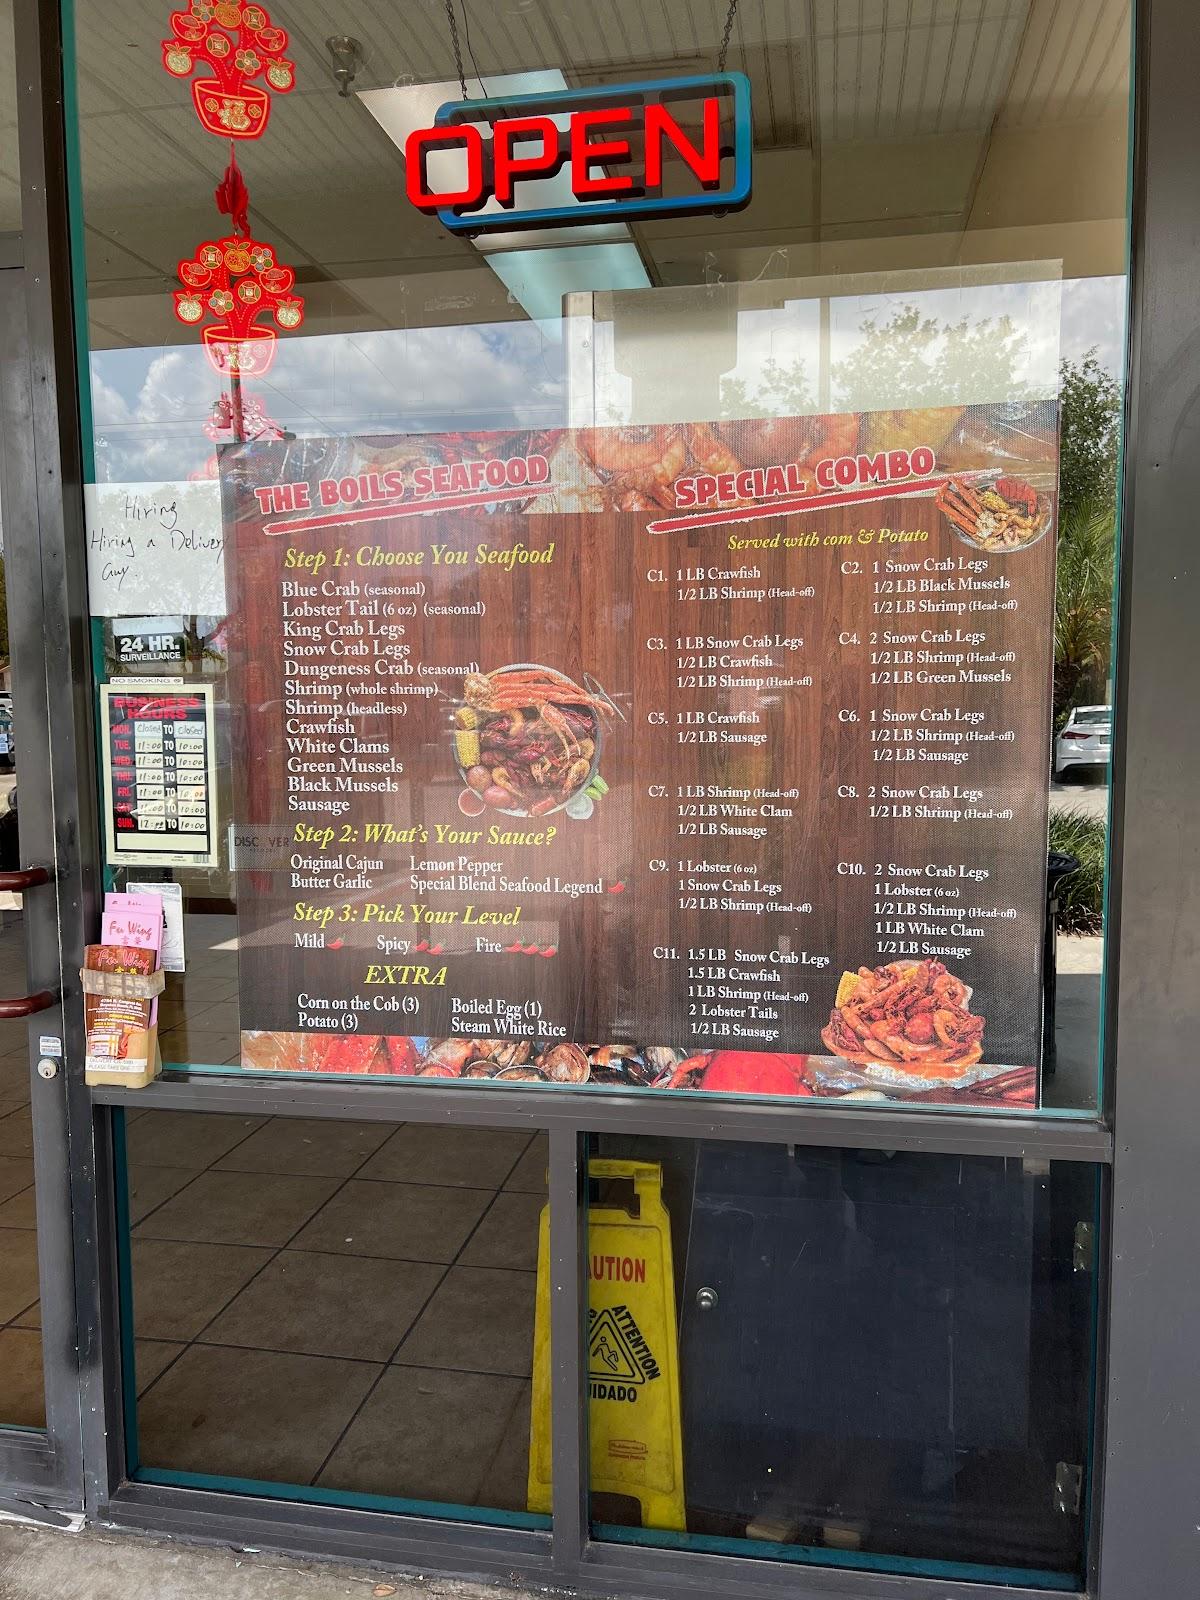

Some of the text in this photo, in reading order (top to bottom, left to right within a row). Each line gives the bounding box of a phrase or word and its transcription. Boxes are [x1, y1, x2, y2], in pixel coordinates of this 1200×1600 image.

[405, 97, 720, 211] OPEN
[254, 454, 550, 515] THE BOILS SEAFOOD
[675, 445, 936, 508] SPECIAL COMBO
[125, 495, 178, 529] Hiring
[90, 527, 135, 558] Hiring
[146, 538, 155, 548] a
[728, 533, 781, 550] Served
[783, 532, 820, 548] with
[858, 529, 875, 544] &
[877, 528, 928, 543] Potato
[285, 543, 555, 575] Step 1: Choose You Seafood
[647, 565, 760, 582] C1. 1 LB Crawfish
[281, 580, 425, 598] Blue Crab (seasonal)
[678, 586, 815, 602] 1/2 LB Shrimp (Head-off)
[282, 599, 486, 618] Lobster Tail (6 oz) (seasonal)
[283, 619, 405, 641] King Crab Legs
[120, 636, 180, 653] 24 HR.
[284, 639, 410, 660] Snow Crab Legs
[120, 651, 181, 663] SURVEILLANCE
[284, 659, 480, 680] Dungeness Crab (seasonal)
[285, 679, 439, 700] Shrimp (whole shrimp)
[113, 697, 199, 708] BUSINESS
[286, 699, 407, 719] Shrimp (headless)
[127, 708, 188, 719] HOURS
[163, 724, 174, 735] TO
[286, 718, 356, 734] Crawfish
[164, 740, 174, 750] TO
[179, 742, 203, 750] 10:00
[286, 737, 390, 753] White Clams
[287, 757, 403, 773] Green Mussels
[287, 776, 399, 793] Black Mussels
[837, 785, 983, 803] C8. 2 Snow Crab Legs
[289, 795, 350, 816] Sausage
[870, 805, 1014, 822] 1/2 LB Shrimp (Head-off)
[117, 818, 134, 828] SUN.
[167, 818, 177, 828] TO
[181, 821, 205, 829] 10:00
[235, 836, 290, 847] DISCVER
[293, 823, 557, 849] Step 2: What's Your Sauce?
[290, 854, 383, 874] Original Cajun
[409, 855, 503, 877] Lemon Pepper
[649, 859, 757, 875] C9. 1 Lobster (6 oz)
[290, 872, 373, 889] Butter Garlic
[410, 874, 603, 898] Special Blend Seafood Legend
[679, 878, 782, 896] 1 Snow Crab Legs
[293, 902, 521, 929] Step 3: Pick Your Level
[679, 897, 812, 915] 1/2 LB Shrimp (Head-off)
[109, 920, 124, 936] Fu
[127, 921, 153, 941] Wing
[294, 932, 502, 955] Mild Spicy Fire
[97, 949, 118, 967] Fu
[122, 949, 150, 975] Wing
[364, 965, 447, 985] EXTRA
[298, 993, 419, 1014] Corn on the Cob (3)
[451, 998, 542, 1020] Boiled Egg (1)
[298, 1012, 358, 1031] Potato (3)
[452, 1017, 566, 1036] Steam White Rice
[588, 1255, 646, 1283] UTION
[610, 1304, 661, 1381] ATTENTION
[588, 1384, 637, 1403] IDADO
